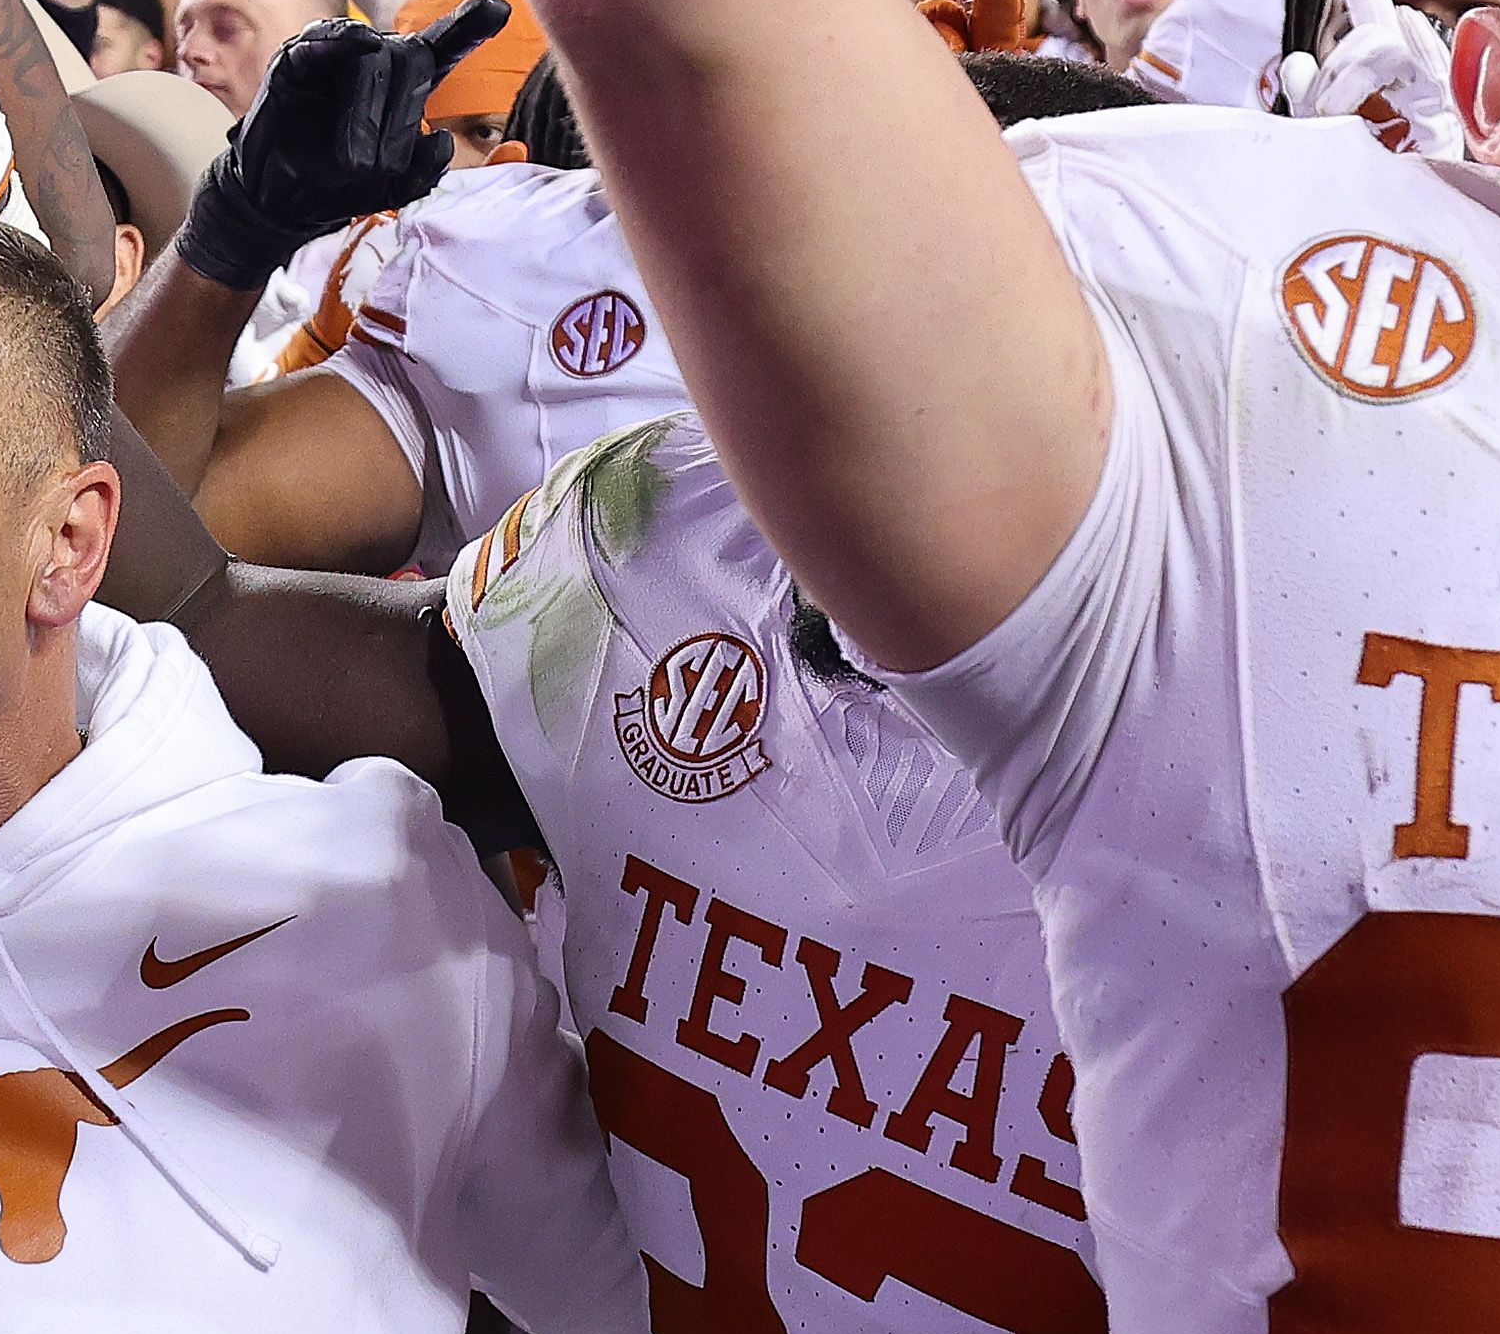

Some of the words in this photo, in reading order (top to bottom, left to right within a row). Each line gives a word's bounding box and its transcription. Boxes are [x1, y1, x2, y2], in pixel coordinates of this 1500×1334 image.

[559, 296, 639, 371] SEC
[1294, 241, 1467, 388] SEC
[654, 639, 758, 754] SEC
[623, 723, 734, 796] GRADUATE
